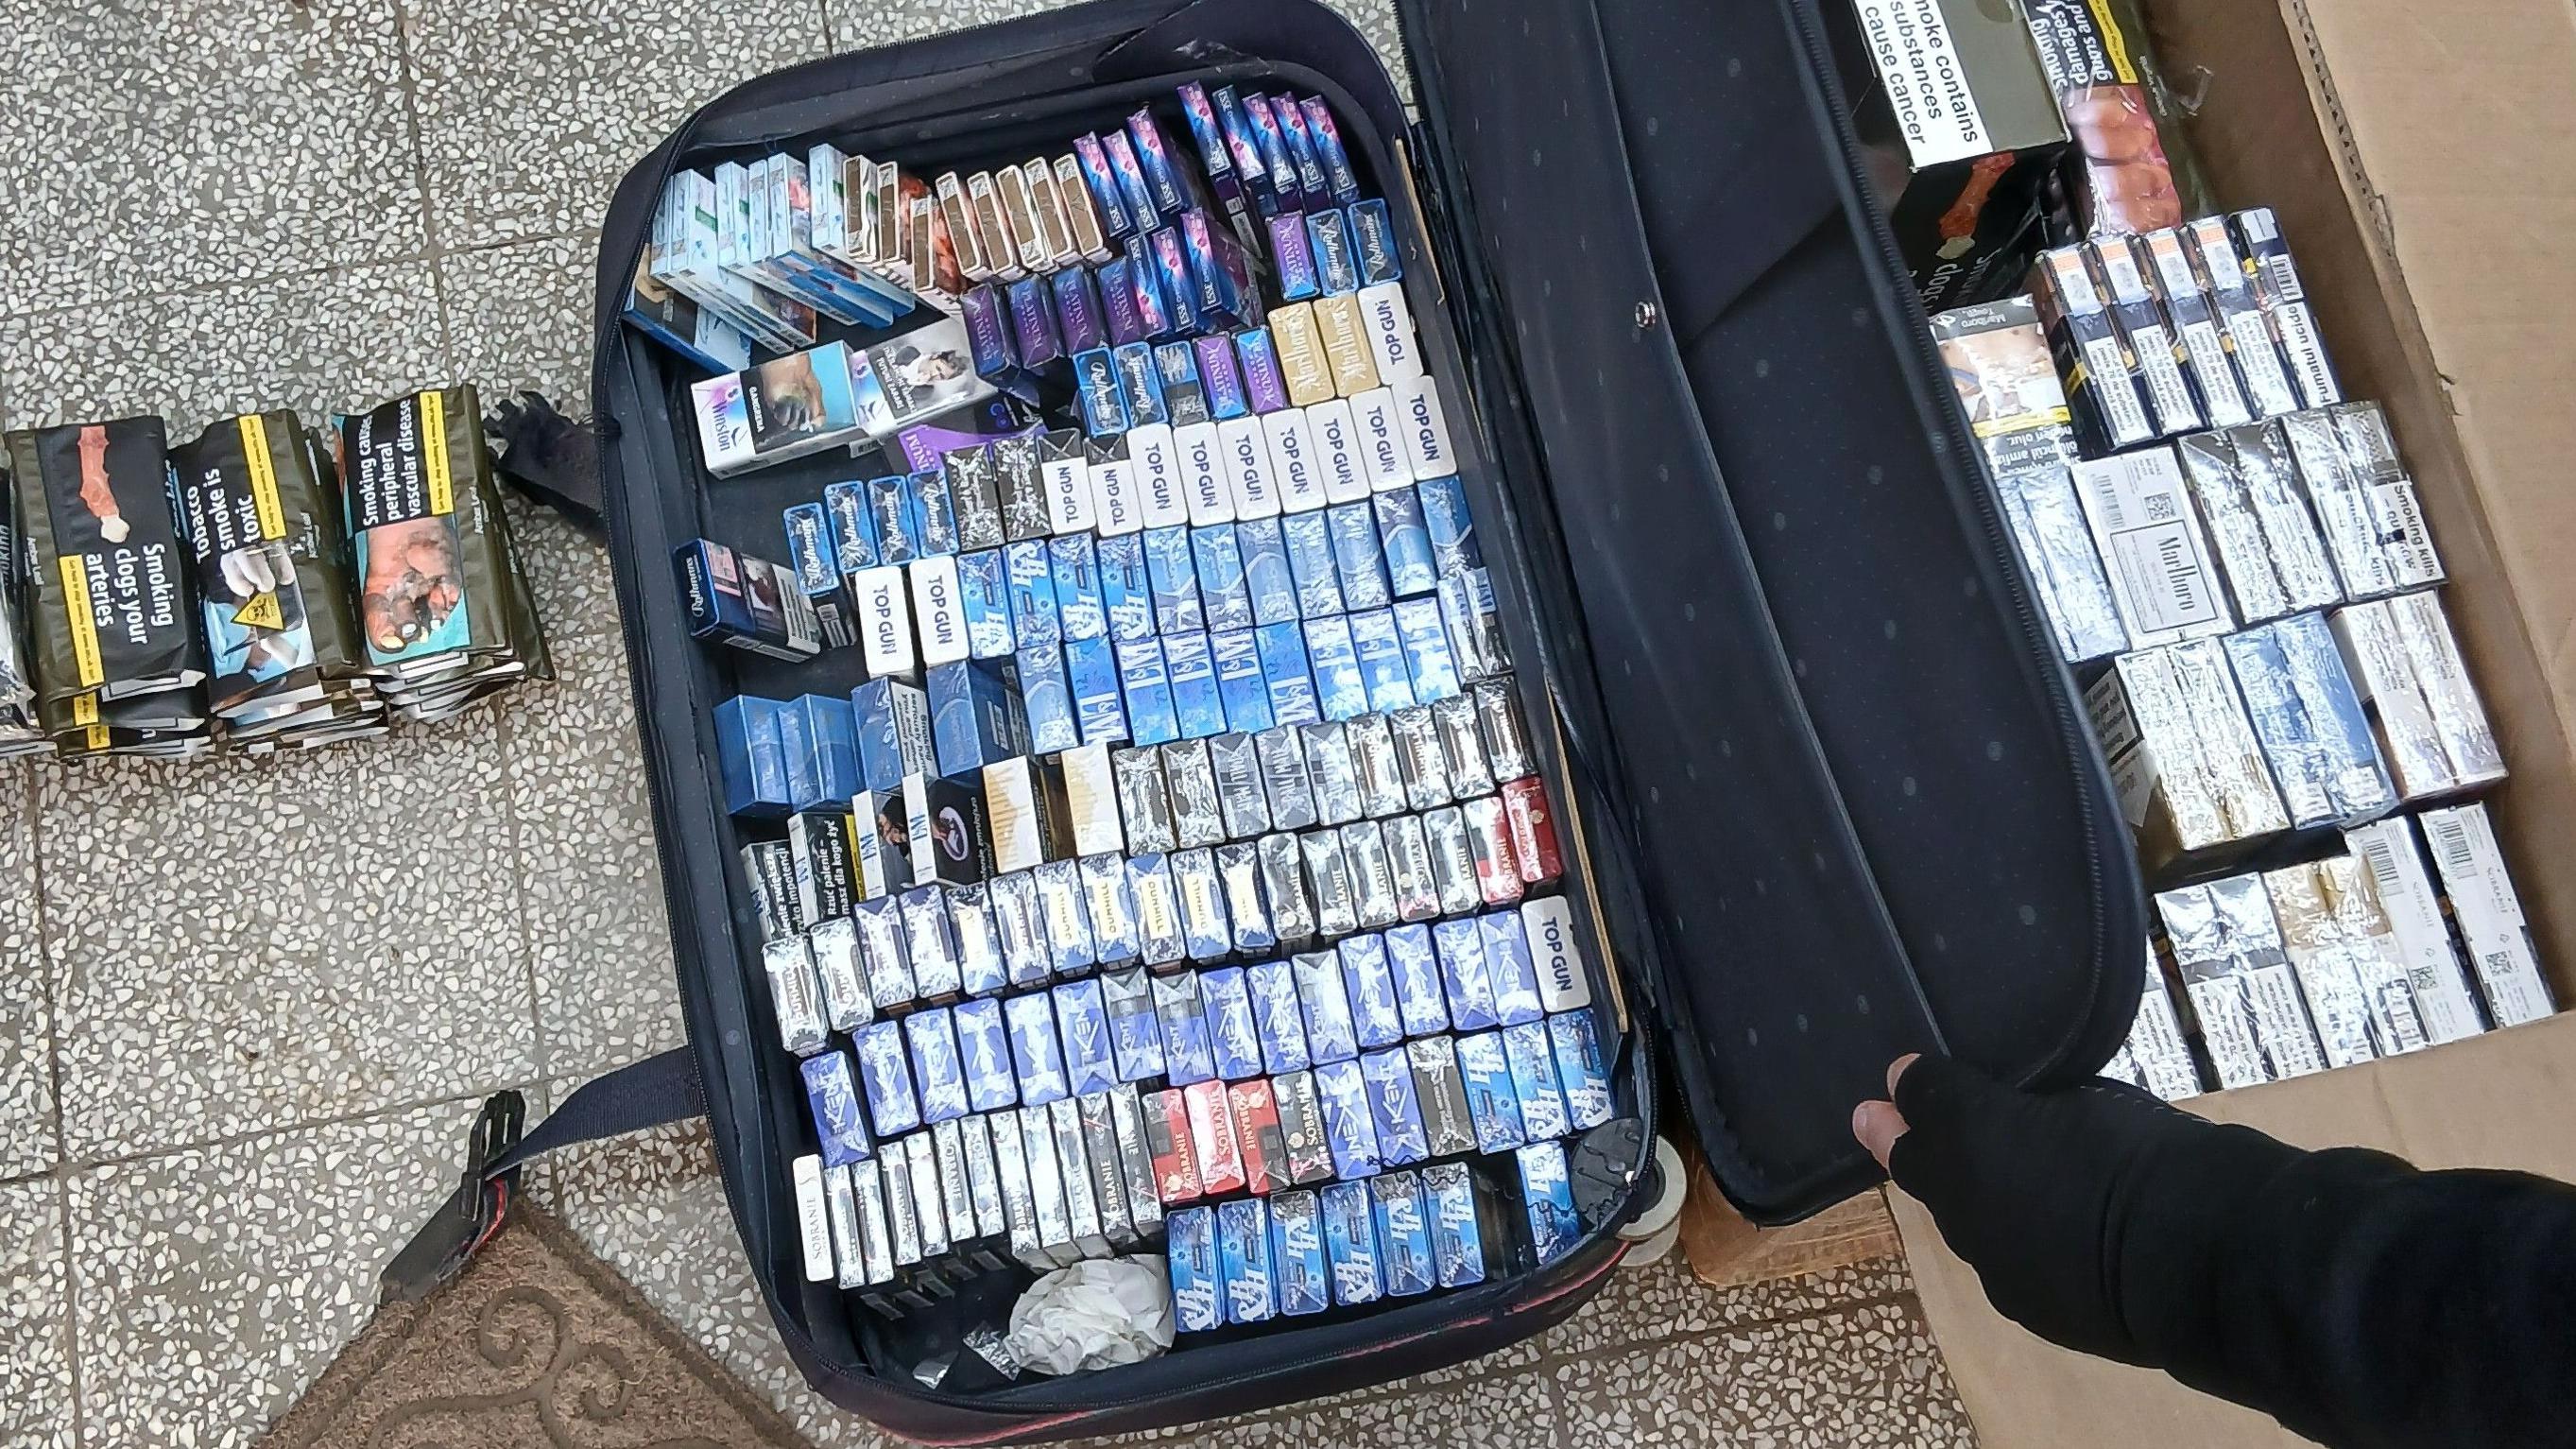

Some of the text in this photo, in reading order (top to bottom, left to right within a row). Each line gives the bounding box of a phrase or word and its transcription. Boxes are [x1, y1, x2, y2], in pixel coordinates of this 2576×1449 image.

[1865, 7, 1926, 146] cause cancer
[1890, 2, 1942, 119] substances
[1914, 0, 1979, 143] moke contains
[2051, 10, 2089, 84] damages
[2065, 5, 2114, 80] gums and
[1373, 299, 1406, 366] TOP GUN
[2288, 306, 2331, 404] Fumatul ucide
[397, 398, 421, 518] vascular disease
[712, 400, 731, 452] Winston
[1280, 426, 1310, 494] TOP GUN
[1324, 418, 1353, 486] TOP GUN
[1367, 405, 1397, 474] TOP GUN
[1410, 393, 1439, 462] TOP GUN
[358, 415, 379, 526] Smoking causes
[375, 441, 404, 521] peripheral
[1057, 465, 1079, 524] TOP GUN
[1105, 468, 1125, 526] TOP GUN
[1145, 441, 1172, 510] TOP GUN
[1191, 440, 1219, 509] TOP GUN
[1235, 434, 1263, 502] TOP GUN
[187, 486, 212, 564] Tobacco
[203, 468, 236, 551] smoke is
[235, 494, 261, 543] toxic
[2394, 485, 2435, 577] Smoking kills
[86, 554, 115, 627] arteries
[113, 548, 148, 645] clogs your
[143, 543, 175, 627] Smoking
[686, 557, 705, 617] Rothmans
[2156, 537, 2198, 611] Marlboro
[872, 584, 898, 656] TOP GUN
[928, 575, 953, 645] TOP GUN
[831, 839, 843, 866] kogo
[834, 868, 846, 886] dla
[1540, 915, 1574, 993] TOP GUN
[1100, 1159, 1125, 1221] OBRANIE
[806, 1194, 823, 1261] SOBRANIE
